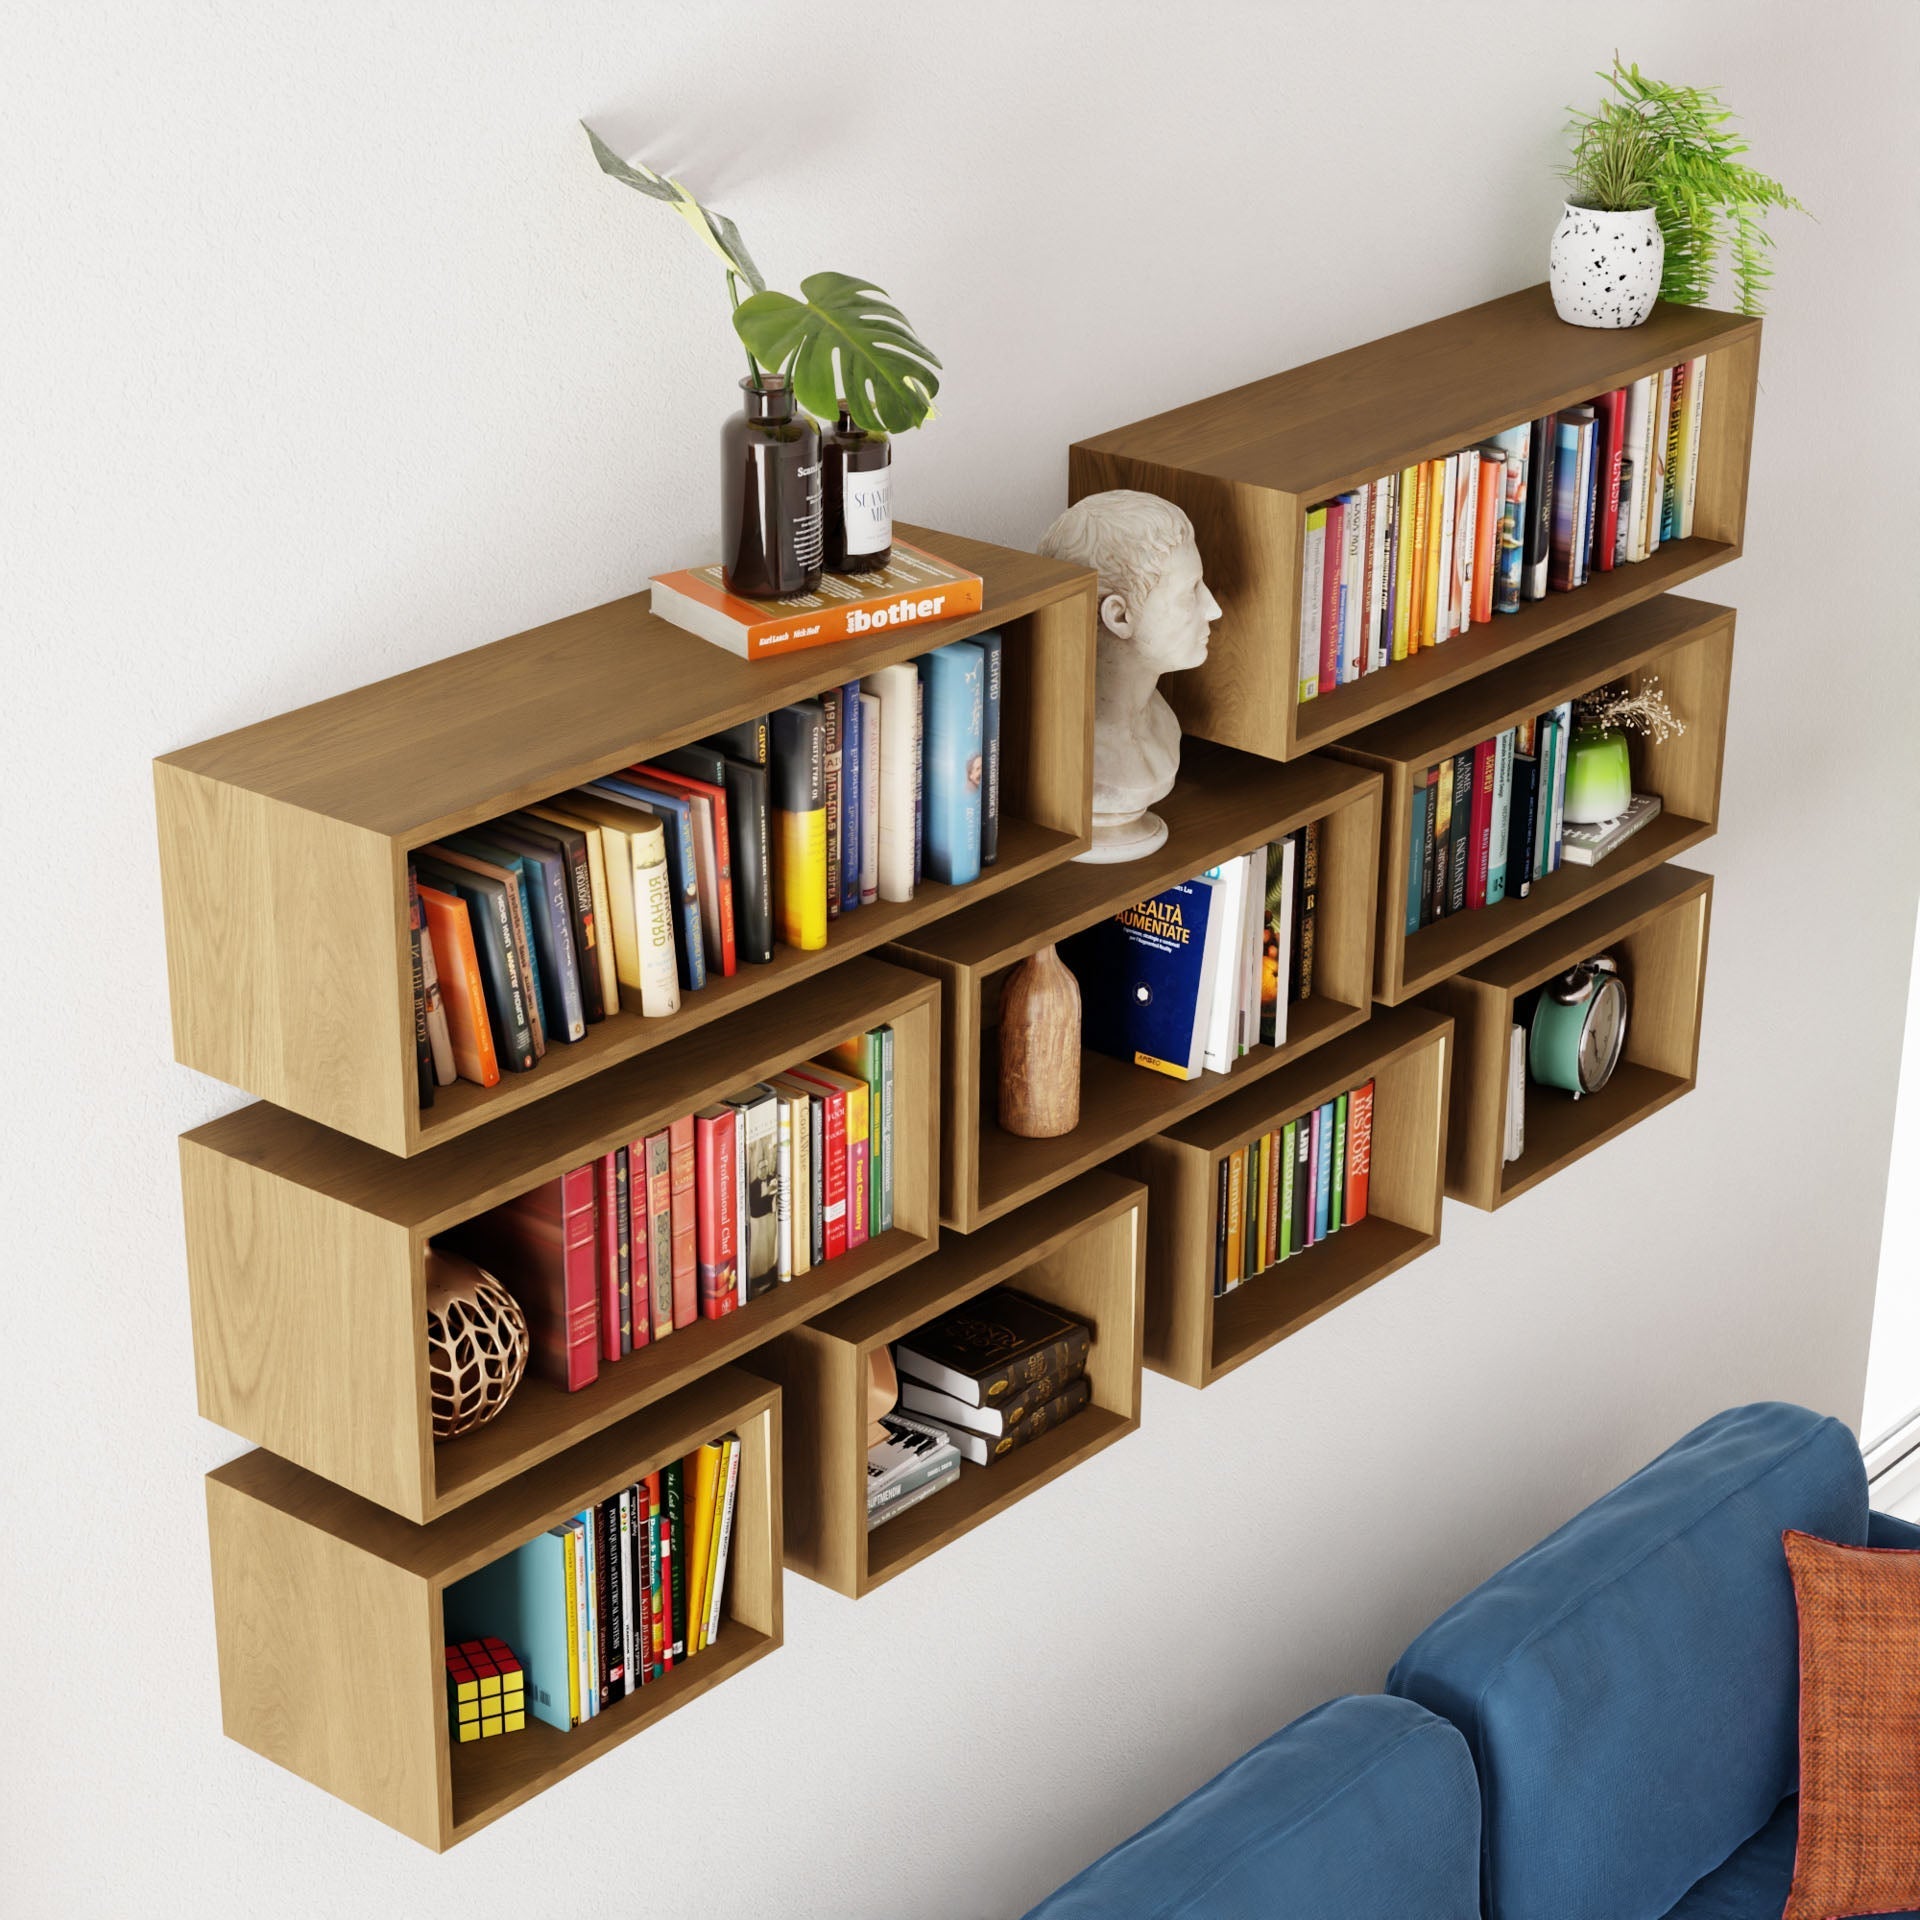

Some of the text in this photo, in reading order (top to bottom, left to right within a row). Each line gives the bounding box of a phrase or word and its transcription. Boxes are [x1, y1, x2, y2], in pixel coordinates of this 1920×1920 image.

[1455, 756, 1465, 806] MAXWELL
[1463, 762, 1471, 793] JAMES
[1424, 801, 1434, 864] GARGOYLE
[1453, 836, 1466, 910] ENCHANTRESS
[1115, 911, 1190, 944] AUMENTATE
[1299, 1128, 1309, 1163] LAW
[1352, 1098, 1364, 1176] HISTORY
[718, 1154, 729, 1226] Professional
[854, 1159, 863, 1231] Food Chemistry
[1229, 1157, 1241, 1234] Chemistry
[1284, 1132, 1295, 1221] SOCIOLOGY
[720, 1225, 730, 1255] Chef
[607, 1508, 616, 1533] POWER
[608, 1533, 617, 1565] QUALITY
[609, 1571, 618, 1616] ELECTRICAL
[610, 1616, 619, 1649] SYSTEMS
